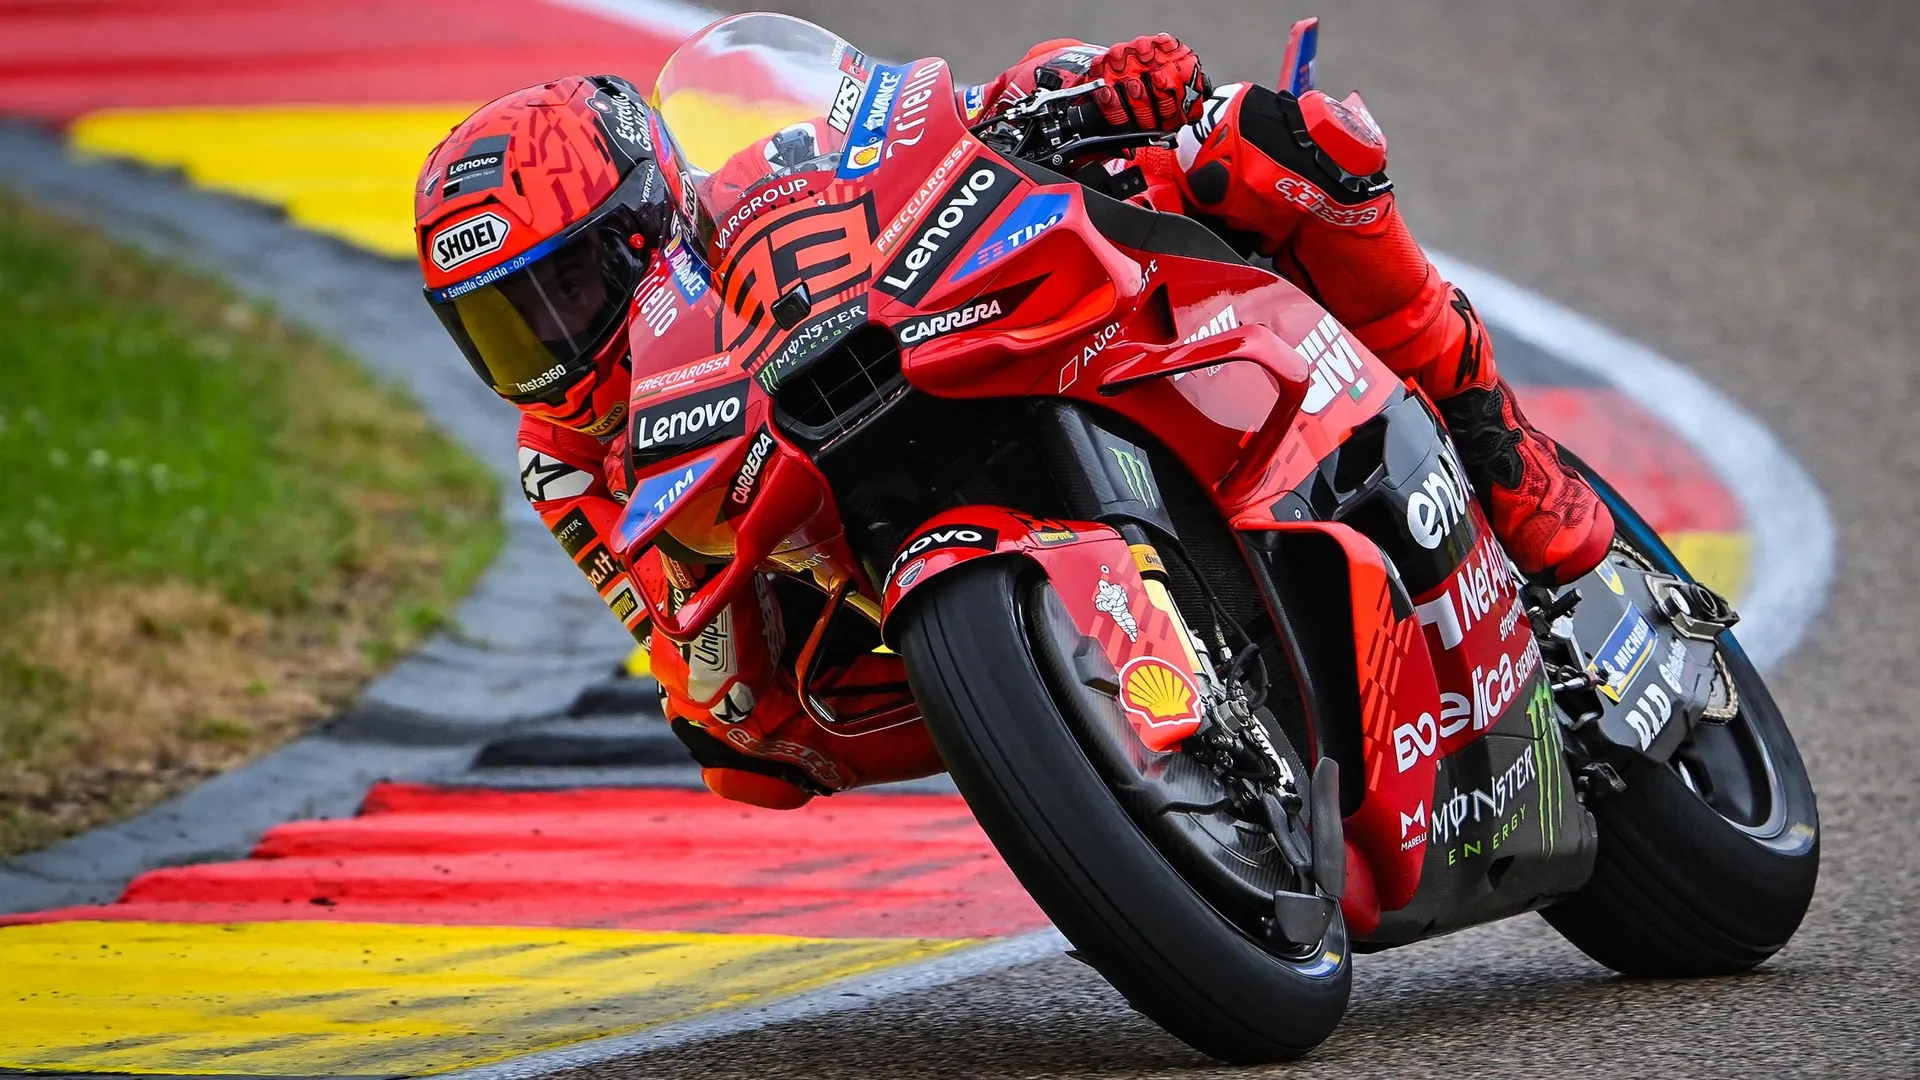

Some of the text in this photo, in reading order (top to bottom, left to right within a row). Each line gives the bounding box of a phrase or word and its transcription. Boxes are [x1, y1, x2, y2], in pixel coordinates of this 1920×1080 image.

[829, 78, 860, 132] WRS
[450, 157, 498, 175] Lenovo
[641, 164, 655, 203] VERTICAL
[715, 178, 808, 249] VARGROUP
[876, 139, 972, 252] FRECCIAROSSA
[437, 220, 497, 263] SHOEI
[883, 169, 995, 291] Lenovo
[1007, 214, 1058, 248] TIM
[448, 279, 477, 298] Estrella
[475, 266, 508, 286] Galicia
[900, 299, 1001, 343] CARRERA
[791, 324, 854, 367] ENERGY
[516, 363, 567, 393] Insta360
[634, 355, 731, 394] FRECCIAROSSA
[638, 396, 741, 450] Lenovo
[731, 431, 773, 504] CARRERA
[654, 468, 694, 514] TIM
[695, 613, 727, 665] Unip
[1400, 832, 1427, 851] MARELLI
[1448, 804, 1526, 865] ENERGY
